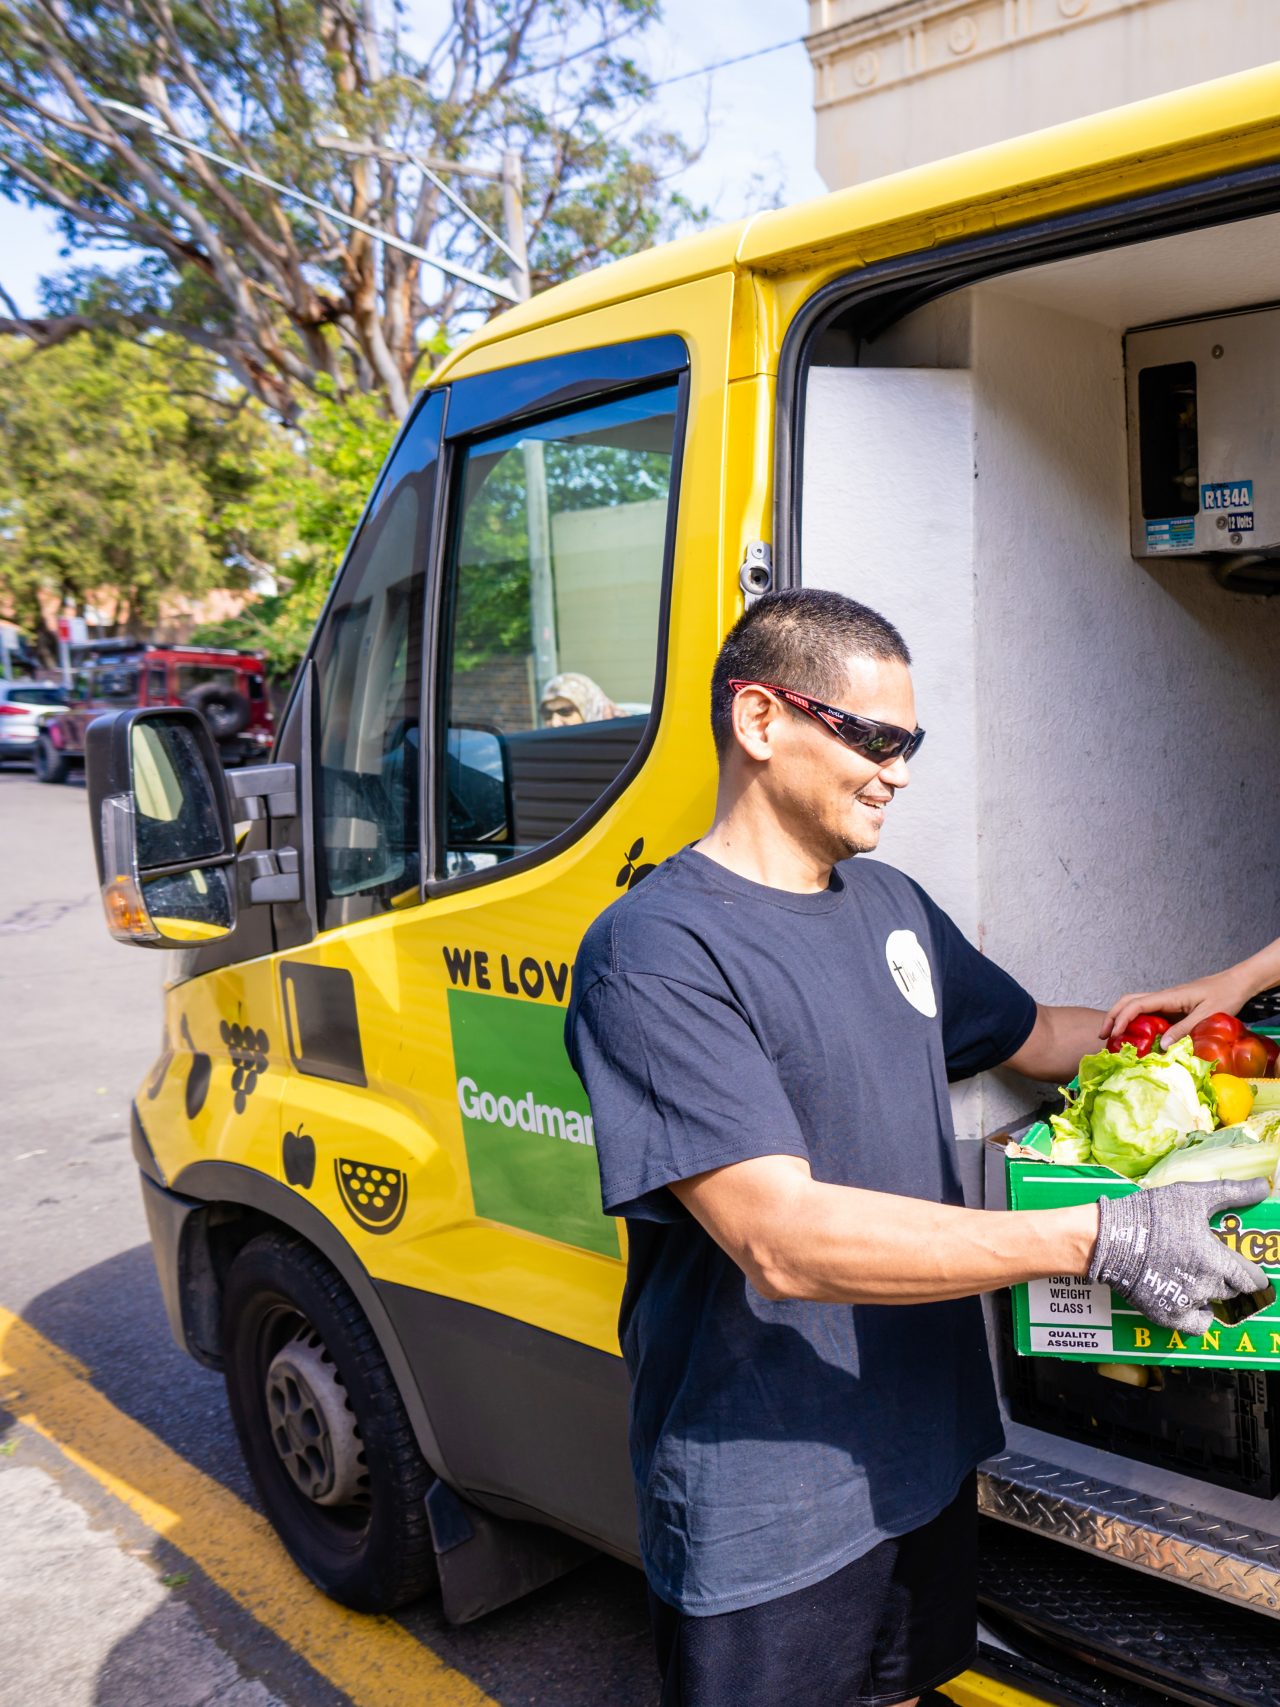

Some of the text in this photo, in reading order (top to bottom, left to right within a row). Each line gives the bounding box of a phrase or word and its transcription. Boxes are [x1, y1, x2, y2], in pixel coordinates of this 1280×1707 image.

[1204, 487, 1250, 508] R134A
[1228, 515, 1253, 529] 12 Volts
[442, 946, 574, 1003] WE LOV
[1048, 1276, 1091, 1287] 15kg NE
[1050, 1288, 1092, 1300] WEIGHT
[1050, 1302, 1092, 1314] CLASS 1
[1048, 1330, 1097, 1339] QUALITY
[1047, 1339, 1099, 1348] ASSURED
